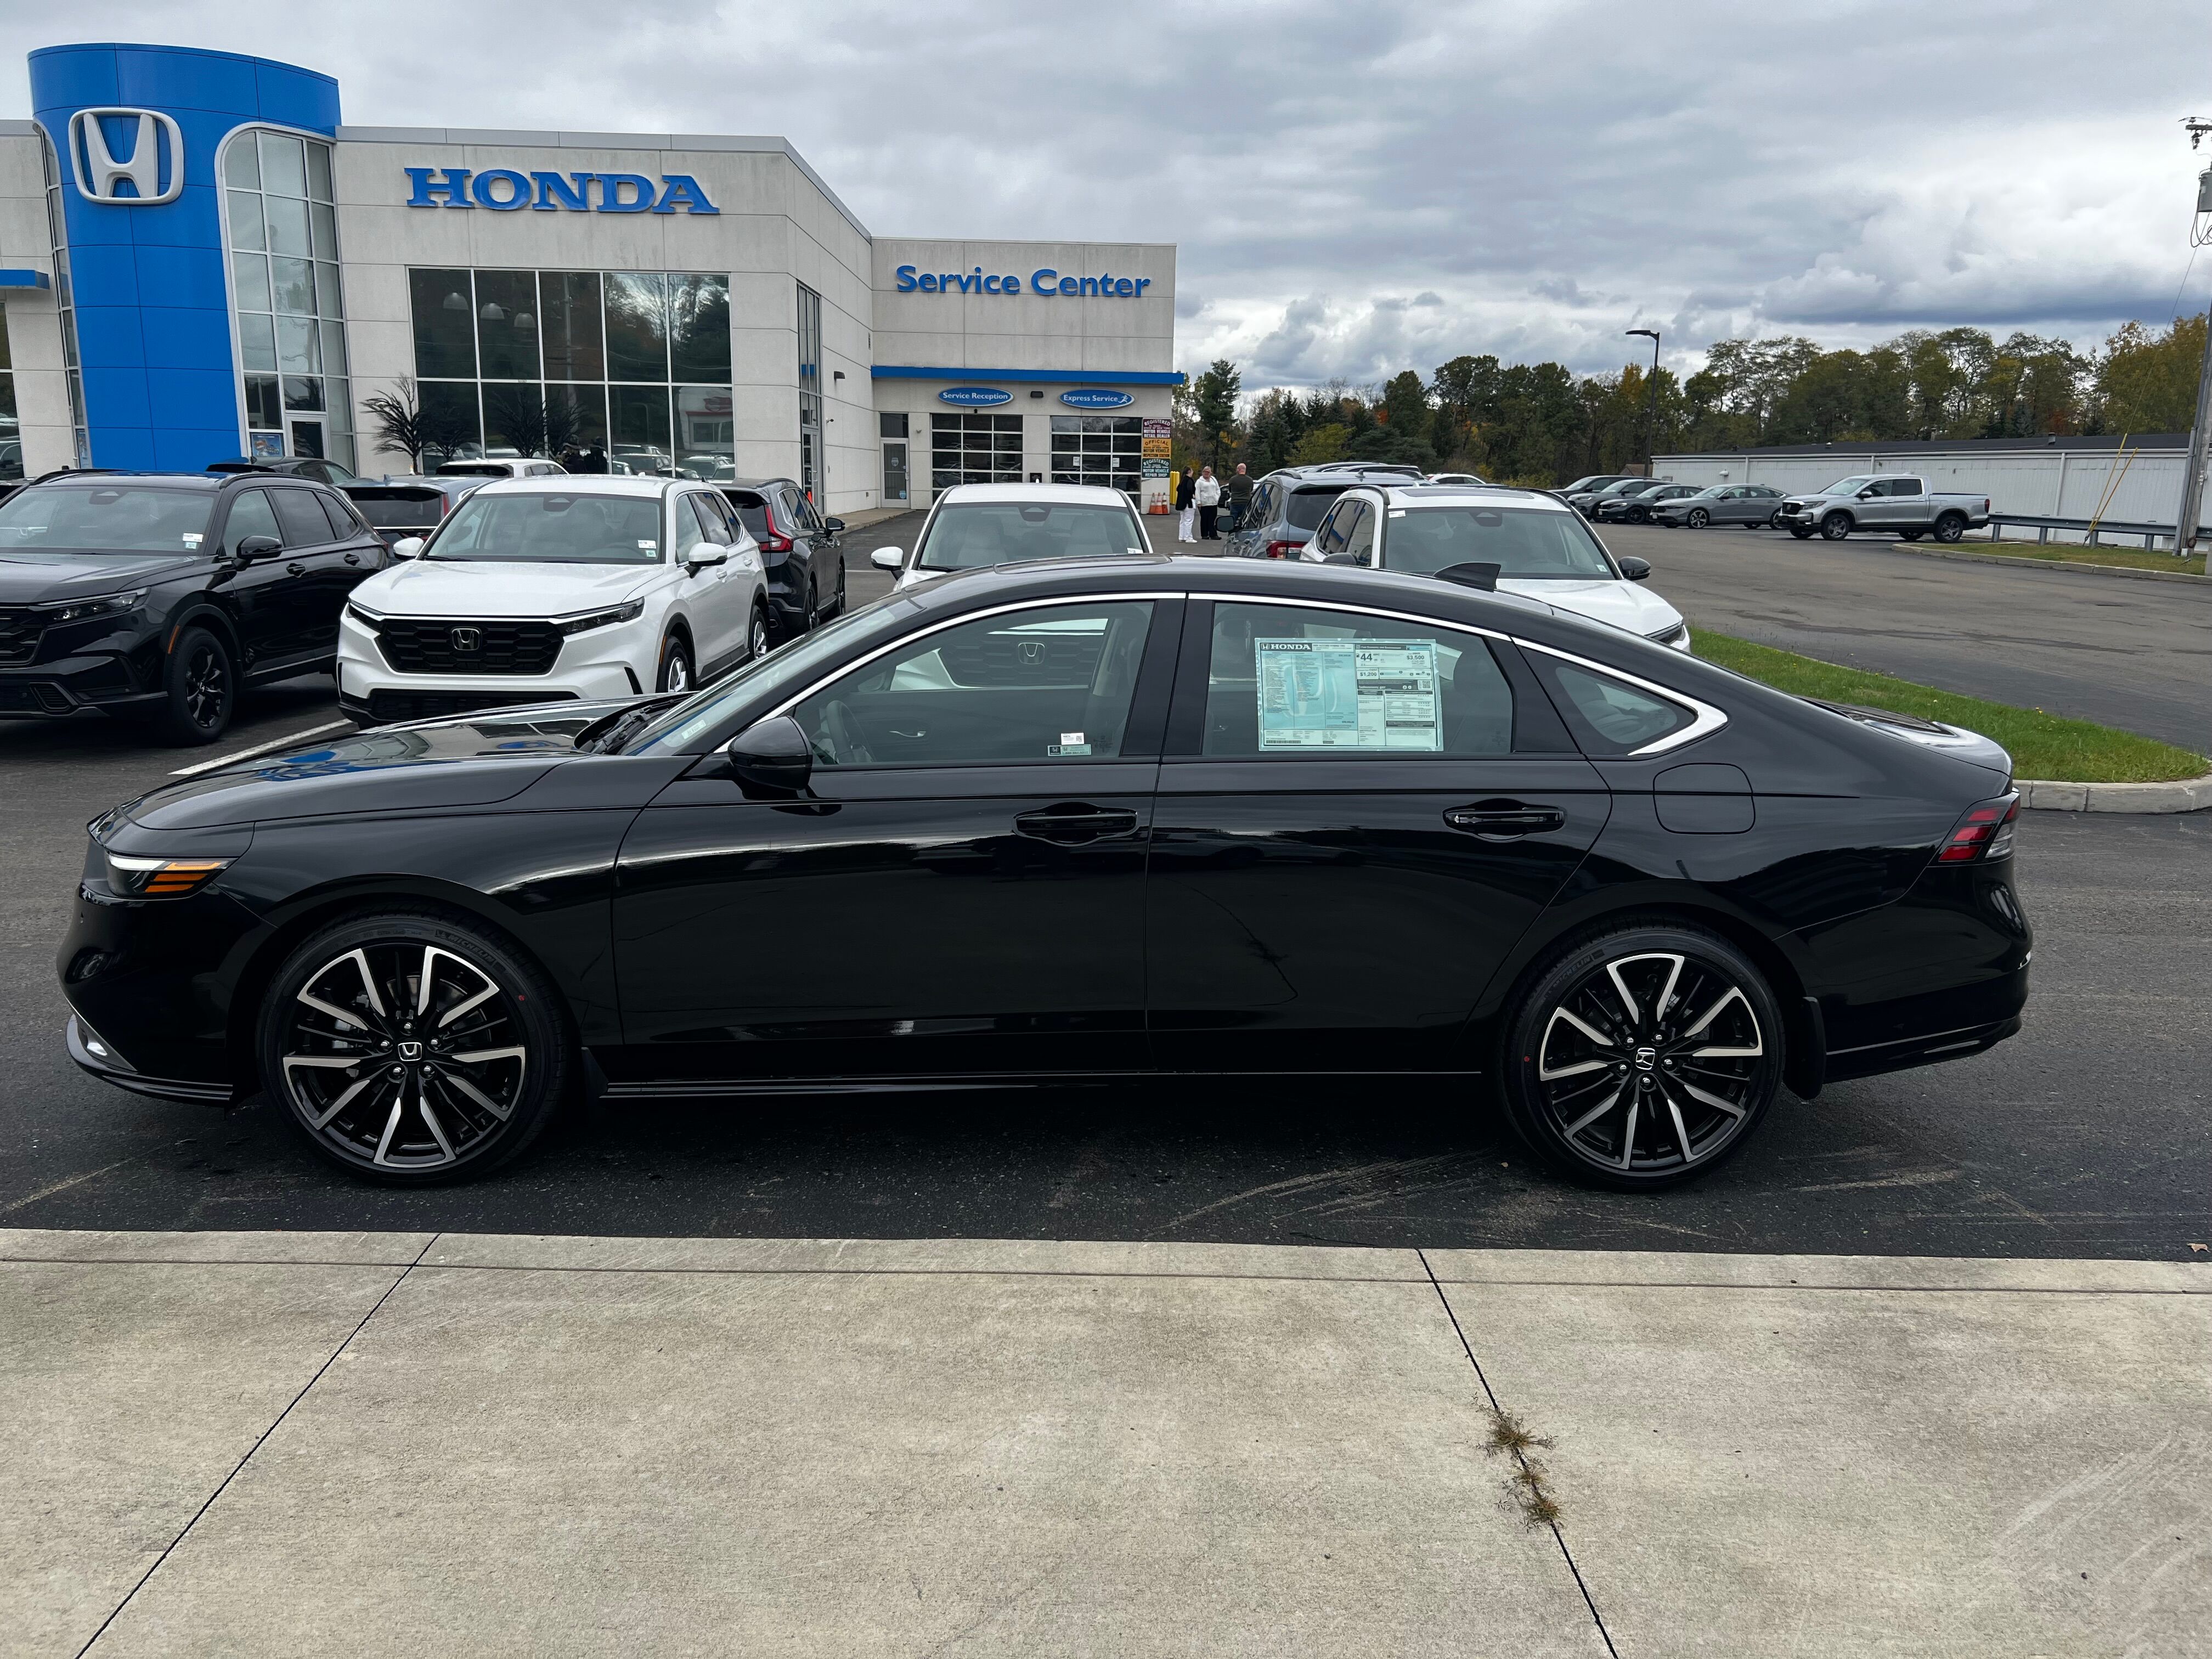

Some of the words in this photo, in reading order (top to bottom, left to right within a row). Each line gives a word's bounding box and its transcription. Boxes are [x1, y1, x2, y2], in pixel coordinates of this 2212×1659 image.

[404, 167, 720, 214] HONDA
[896, 265, 1020, 295] Service
[1030, 268, 1151, 297] Center
[447, 933, 496, 963] MICHELIN
[1552, 955, 1592, 988] MICHELIN
